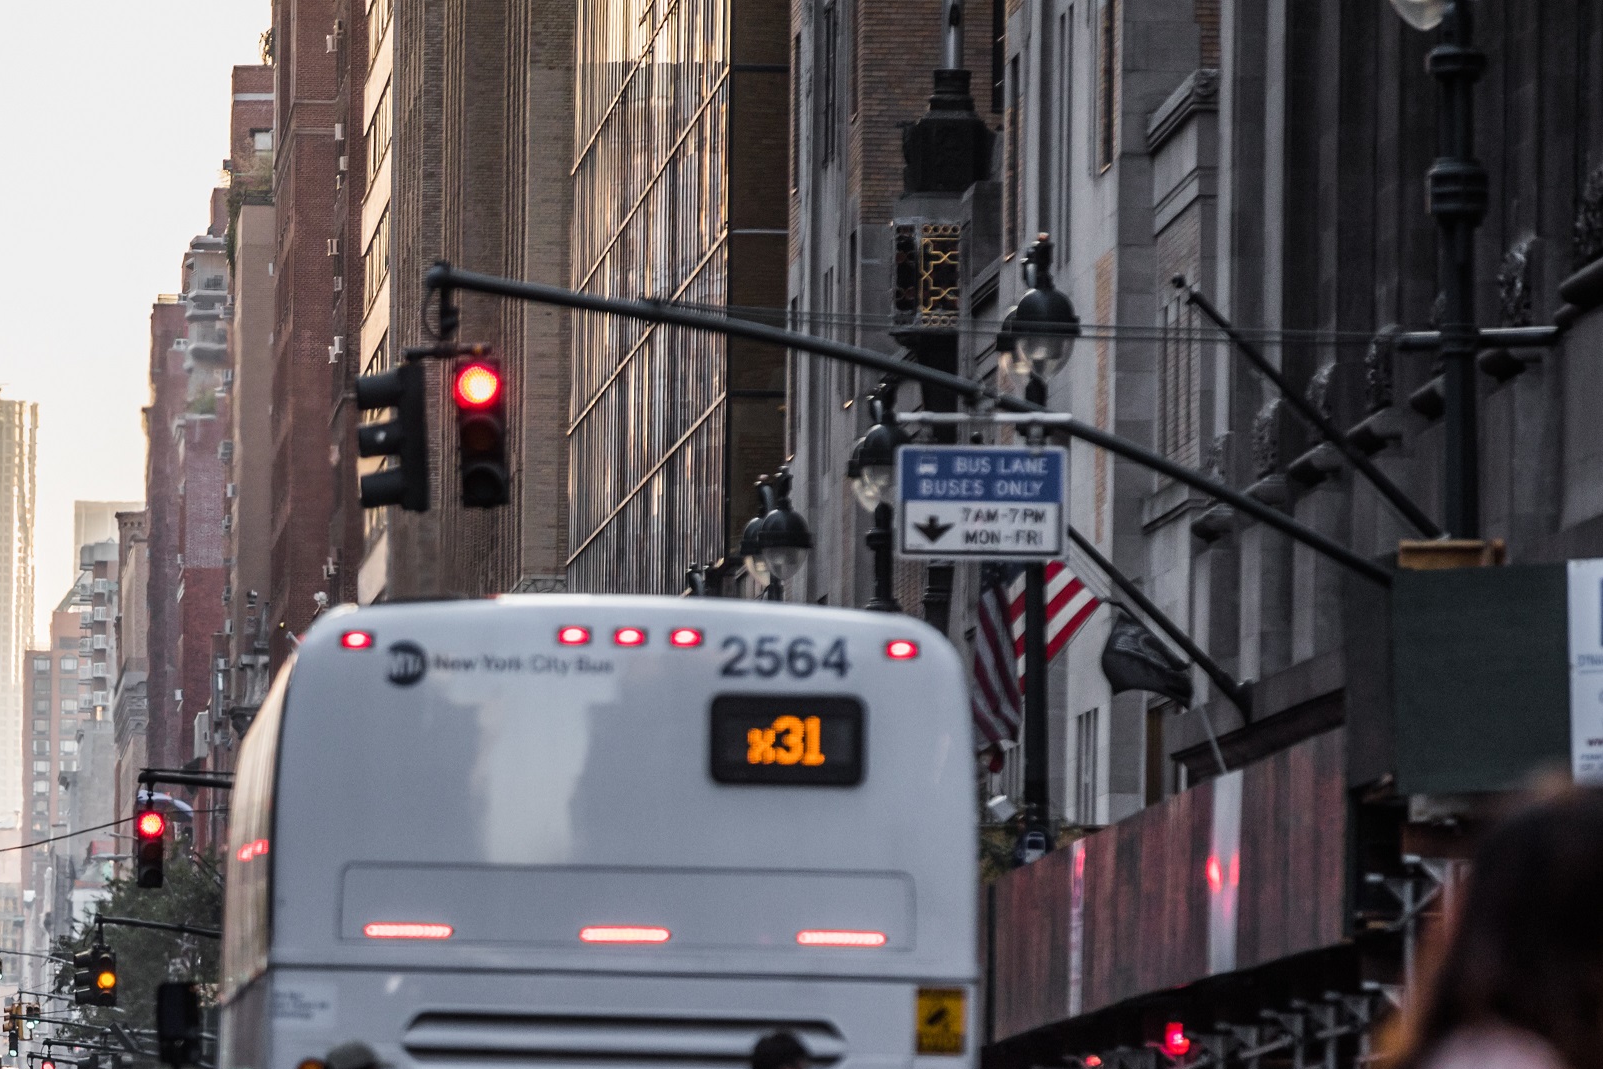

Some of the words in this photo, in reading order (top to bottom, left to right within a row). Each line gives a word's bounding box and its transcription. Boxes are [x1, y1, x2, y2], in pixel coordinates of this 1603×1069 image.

[954, 456, 991, 475] BUS
[997, 457, 1048, 475] LANE
[918, 479, 985, 497] BUSES
[995, 480, 1044, 497] ONLY
[964, 529, 1044, 546] MON-FRI
[434, 653, 475, 671] New
[482, 653, 522, 671] York
[530, 653, 571, 676] City
[576, 653, 615, 673] Bus
[720, 634, 852, 679] 2564
